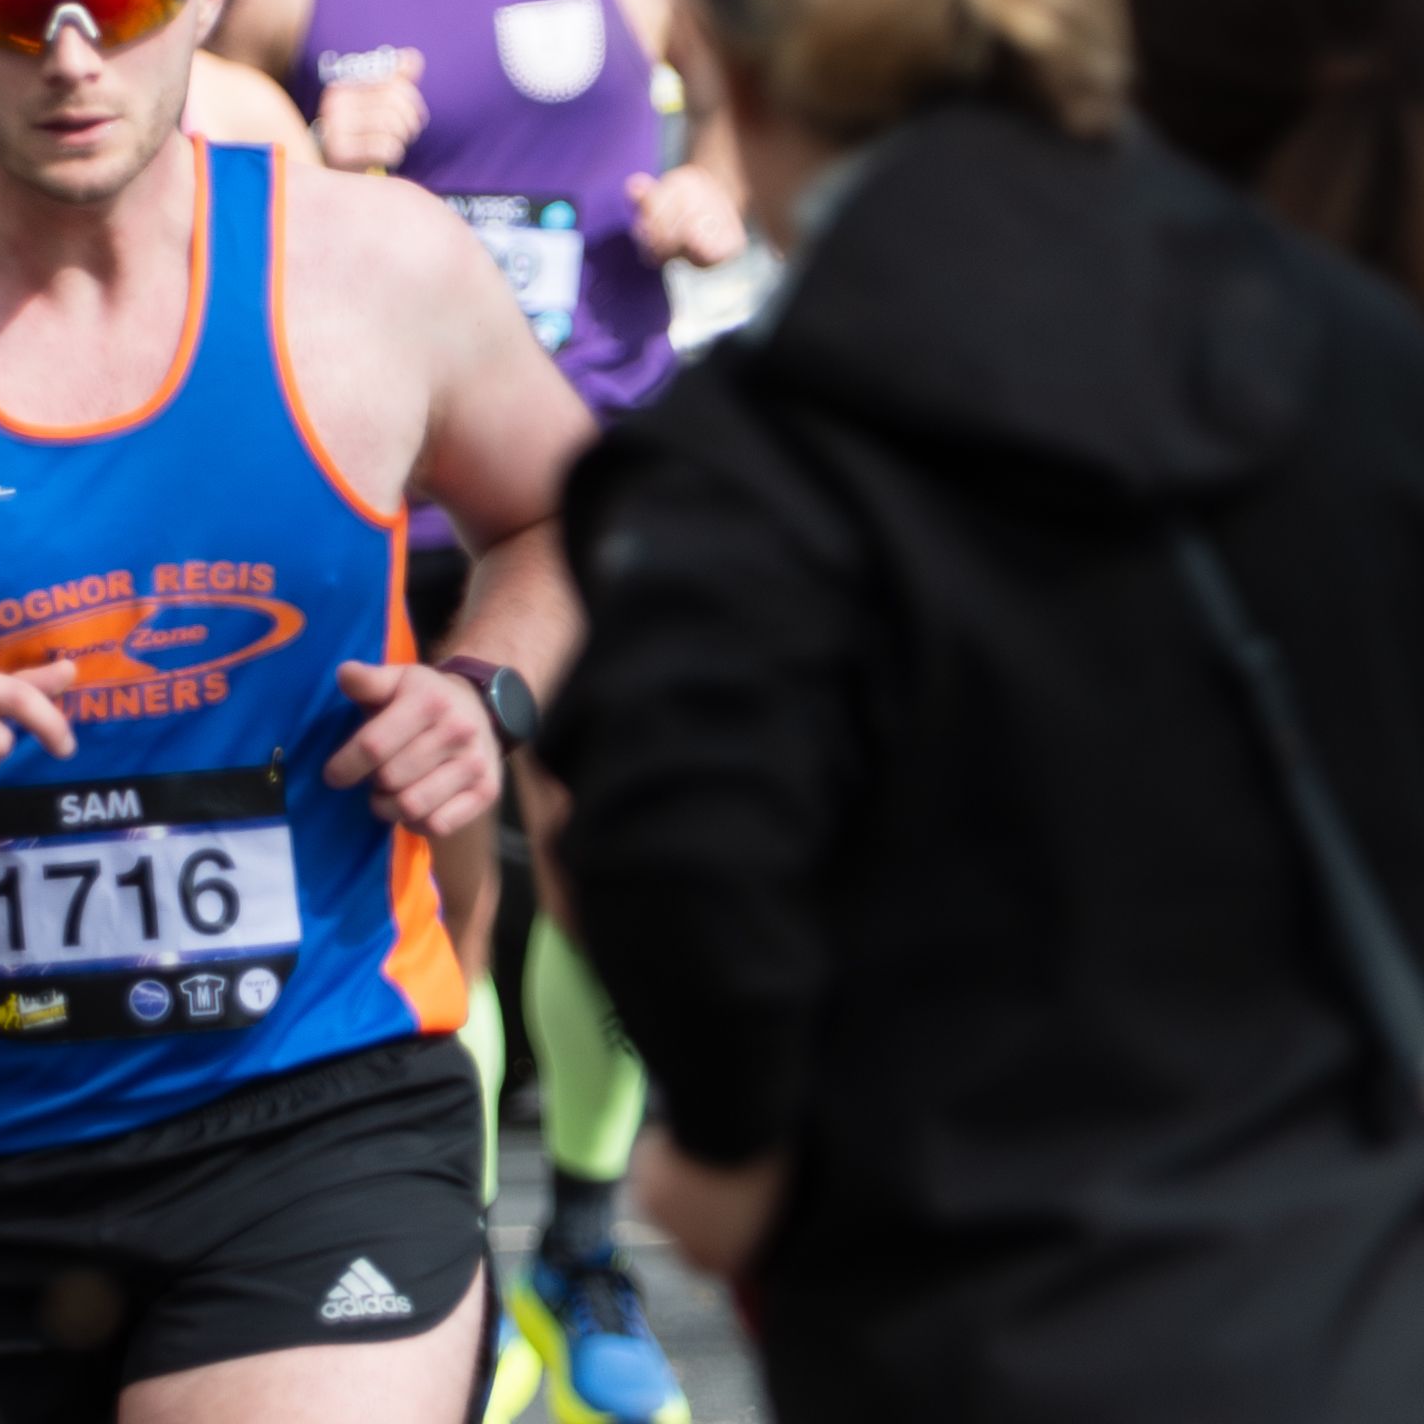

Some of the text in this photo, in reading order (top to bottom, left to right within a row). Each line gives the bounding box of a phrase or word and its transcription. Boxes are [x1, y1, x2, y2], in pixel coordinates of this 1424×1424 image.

[152, 559, 276, 595] REGIS
[128, 624, 208, 650] Zone
[59, 671, 230, 724] NNERS
[58, 788, 142, 824] SAM
[320, 1294, 413, 1320] adidas
